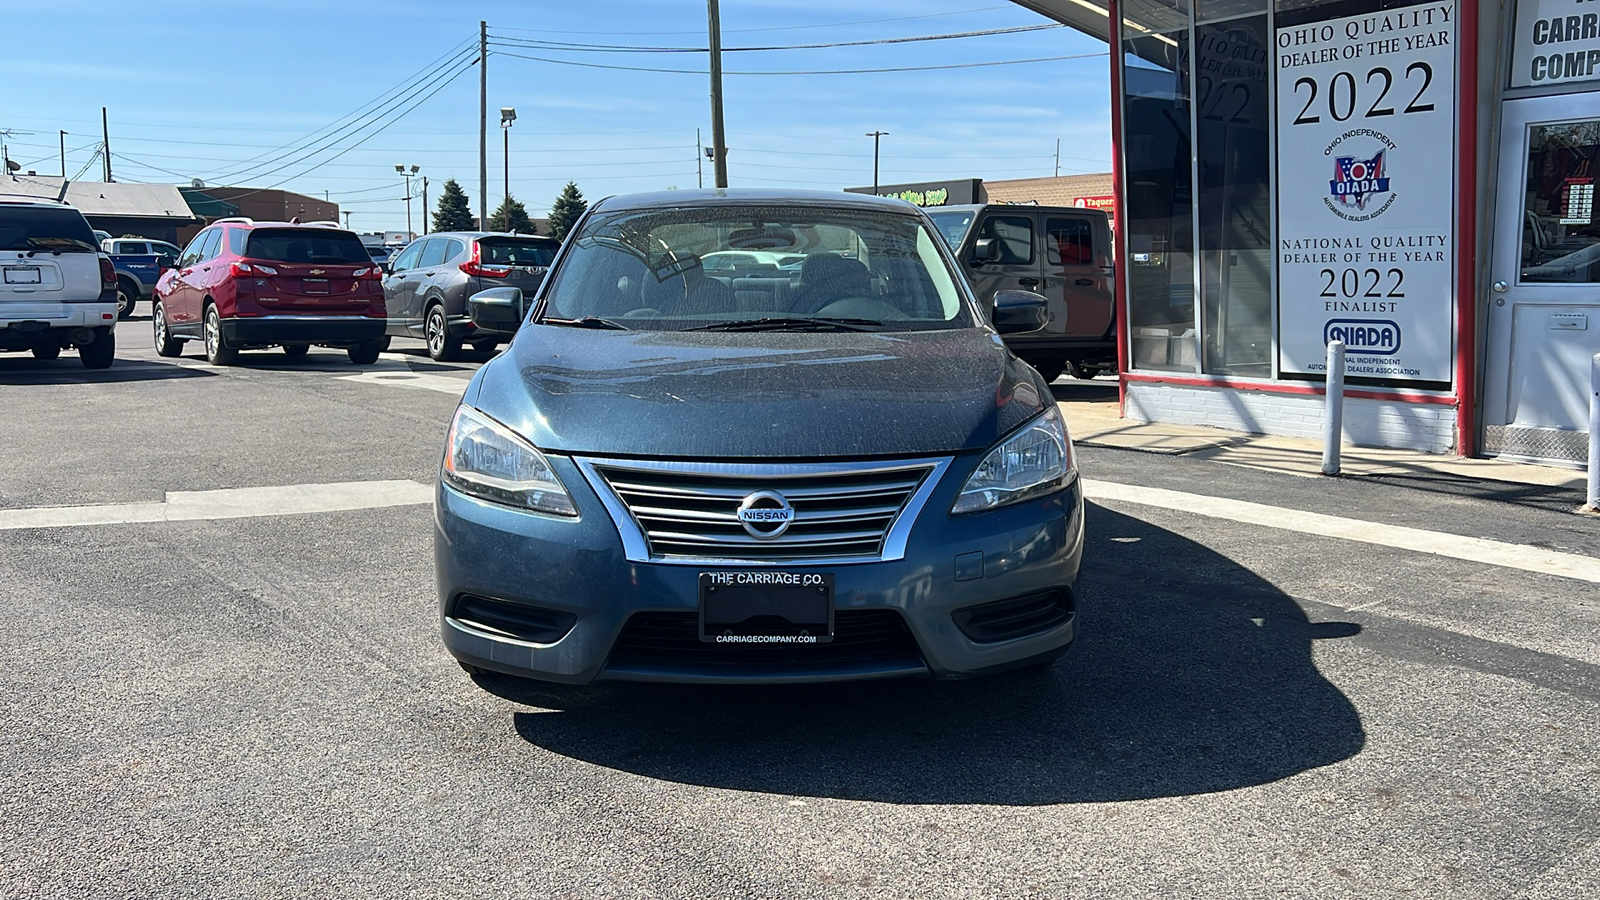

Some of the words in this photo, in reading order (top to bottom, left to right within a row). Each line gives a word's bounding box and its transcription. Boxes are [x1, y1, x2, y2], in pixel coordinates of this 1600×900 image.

[1278, 26, 1334, 48] OHIO
[1346, 4, 1452, 40] QUALITY
[1533, 13, 1600, 45] CARR
[1281, 48, 1339, 68] DEALER
[1343, 44, 1363, 59] OF
[1367, 38, 1400, 56] THE
[1405, 31, 1450, 50] YEAR
[1292, 62, 1435, 125] 2022
[1324, 137, 1341, 156] OHIO
[1342, 129, 1396, 150] INDEPENDENT
[1337, 180, 1379, 193] OIADA
[926, 188, 947, 205] SHOP
[1086, 198, 1114, 208] Taquer
[1323, 197, 1348, 220] AUTOMOBILE
[1370, 192, 1397, 219] ASSOCIATION
[1282, 238, 1363, 249] NATIONAL
[1371, 235, 1447, 249] QUALITY
[1284, 253, 1337, 263] DEALER
[1344, 252, 1361, 262] OF
[1368, 252, 1397, 262] THE
[1404, 252, 1444, 262] YEAR
[1320, 268, 1405, 298] 2022
[1325, 302, 1397, 312] FINALIST
[1330, 327, 1392, 346] NIADA
[711, 574, 734, 583] THE
[737, 574, 800, 584] CARRIAGE
[803, 574, 824, 584] CO.
